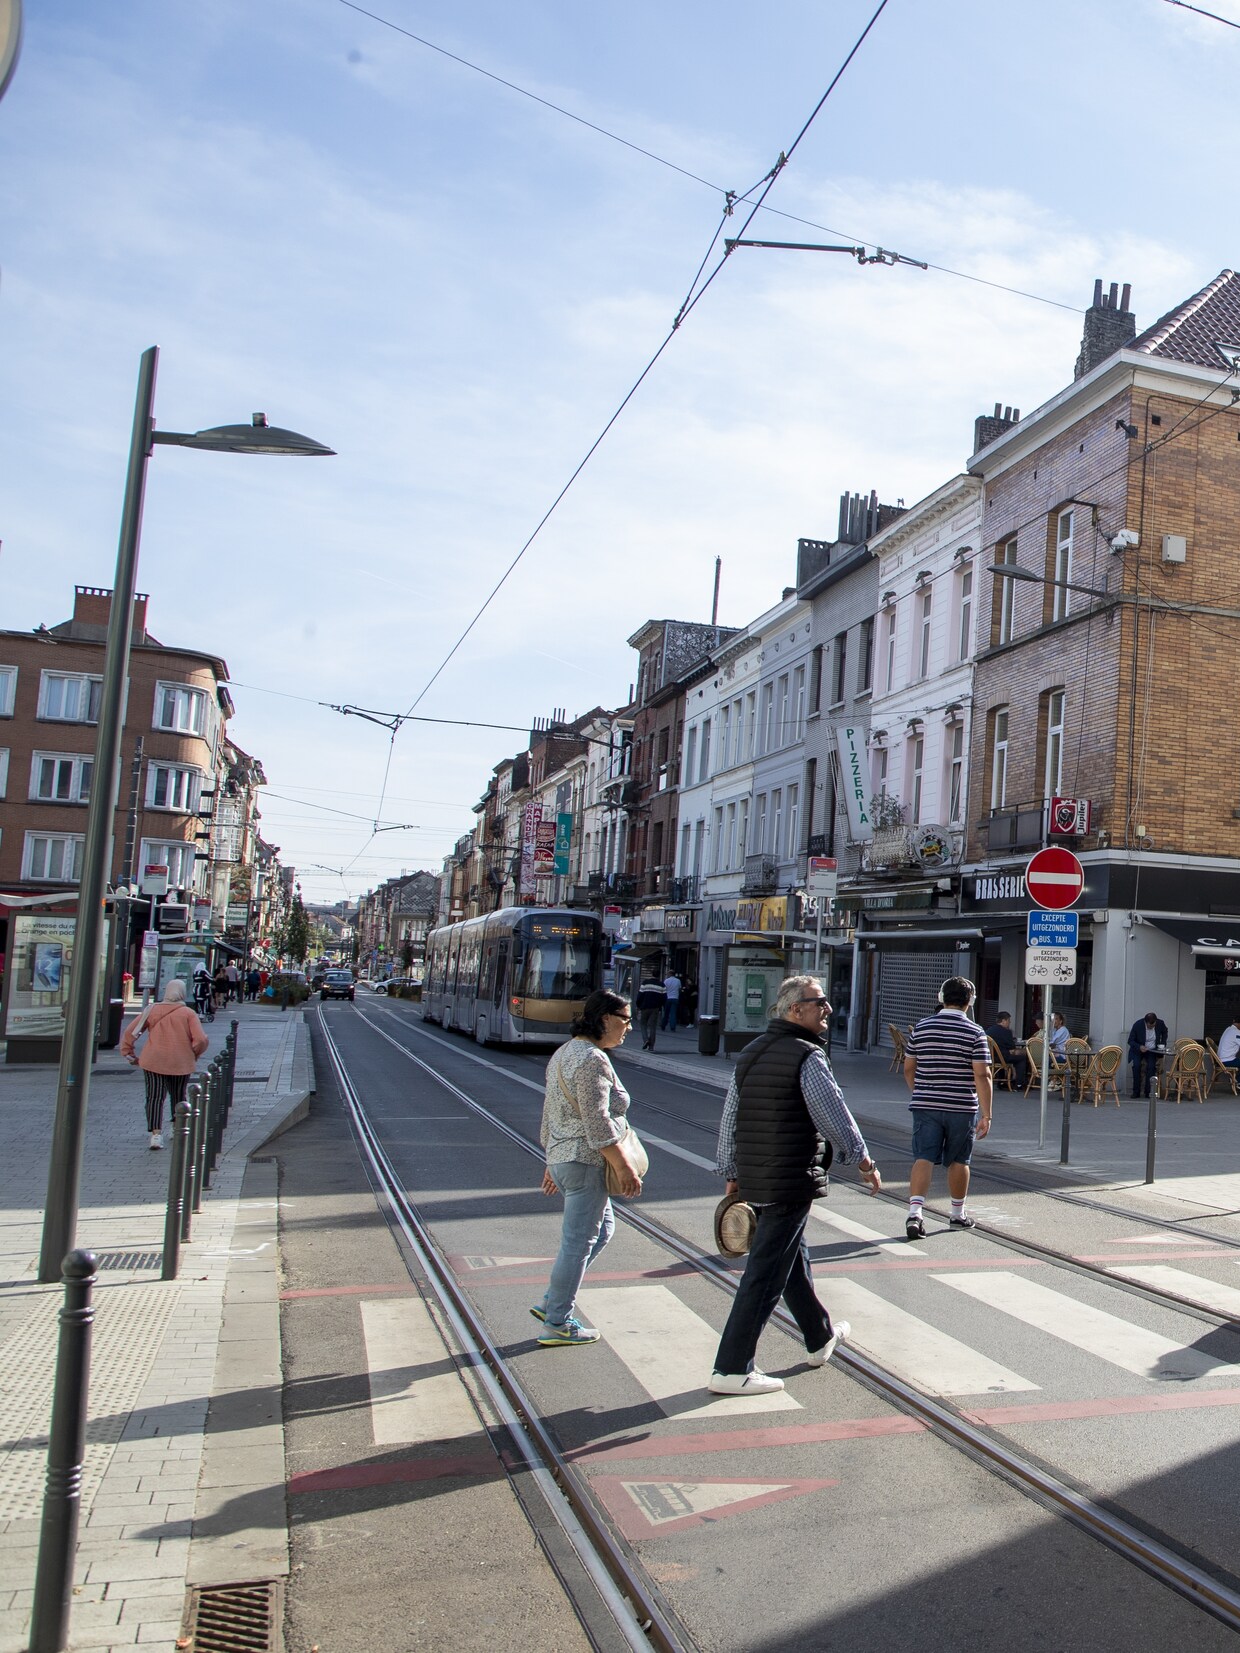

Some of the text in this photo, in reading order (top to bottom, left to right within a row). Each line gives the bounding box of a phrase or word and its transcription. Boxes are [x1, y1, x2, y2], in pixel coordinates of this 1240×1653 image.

[846, 728, 868, 824] PIZZERIA
[1077, 801, 1086, 832] Jupiler
[975, 875, 1026, 900] BRASSERIE
[1041, 914, 1066, 922] EXCEPTE
[1032, 923, 1075, 932] UITGEZONDERD
[1055, 936, 1068, 944] TAXI
